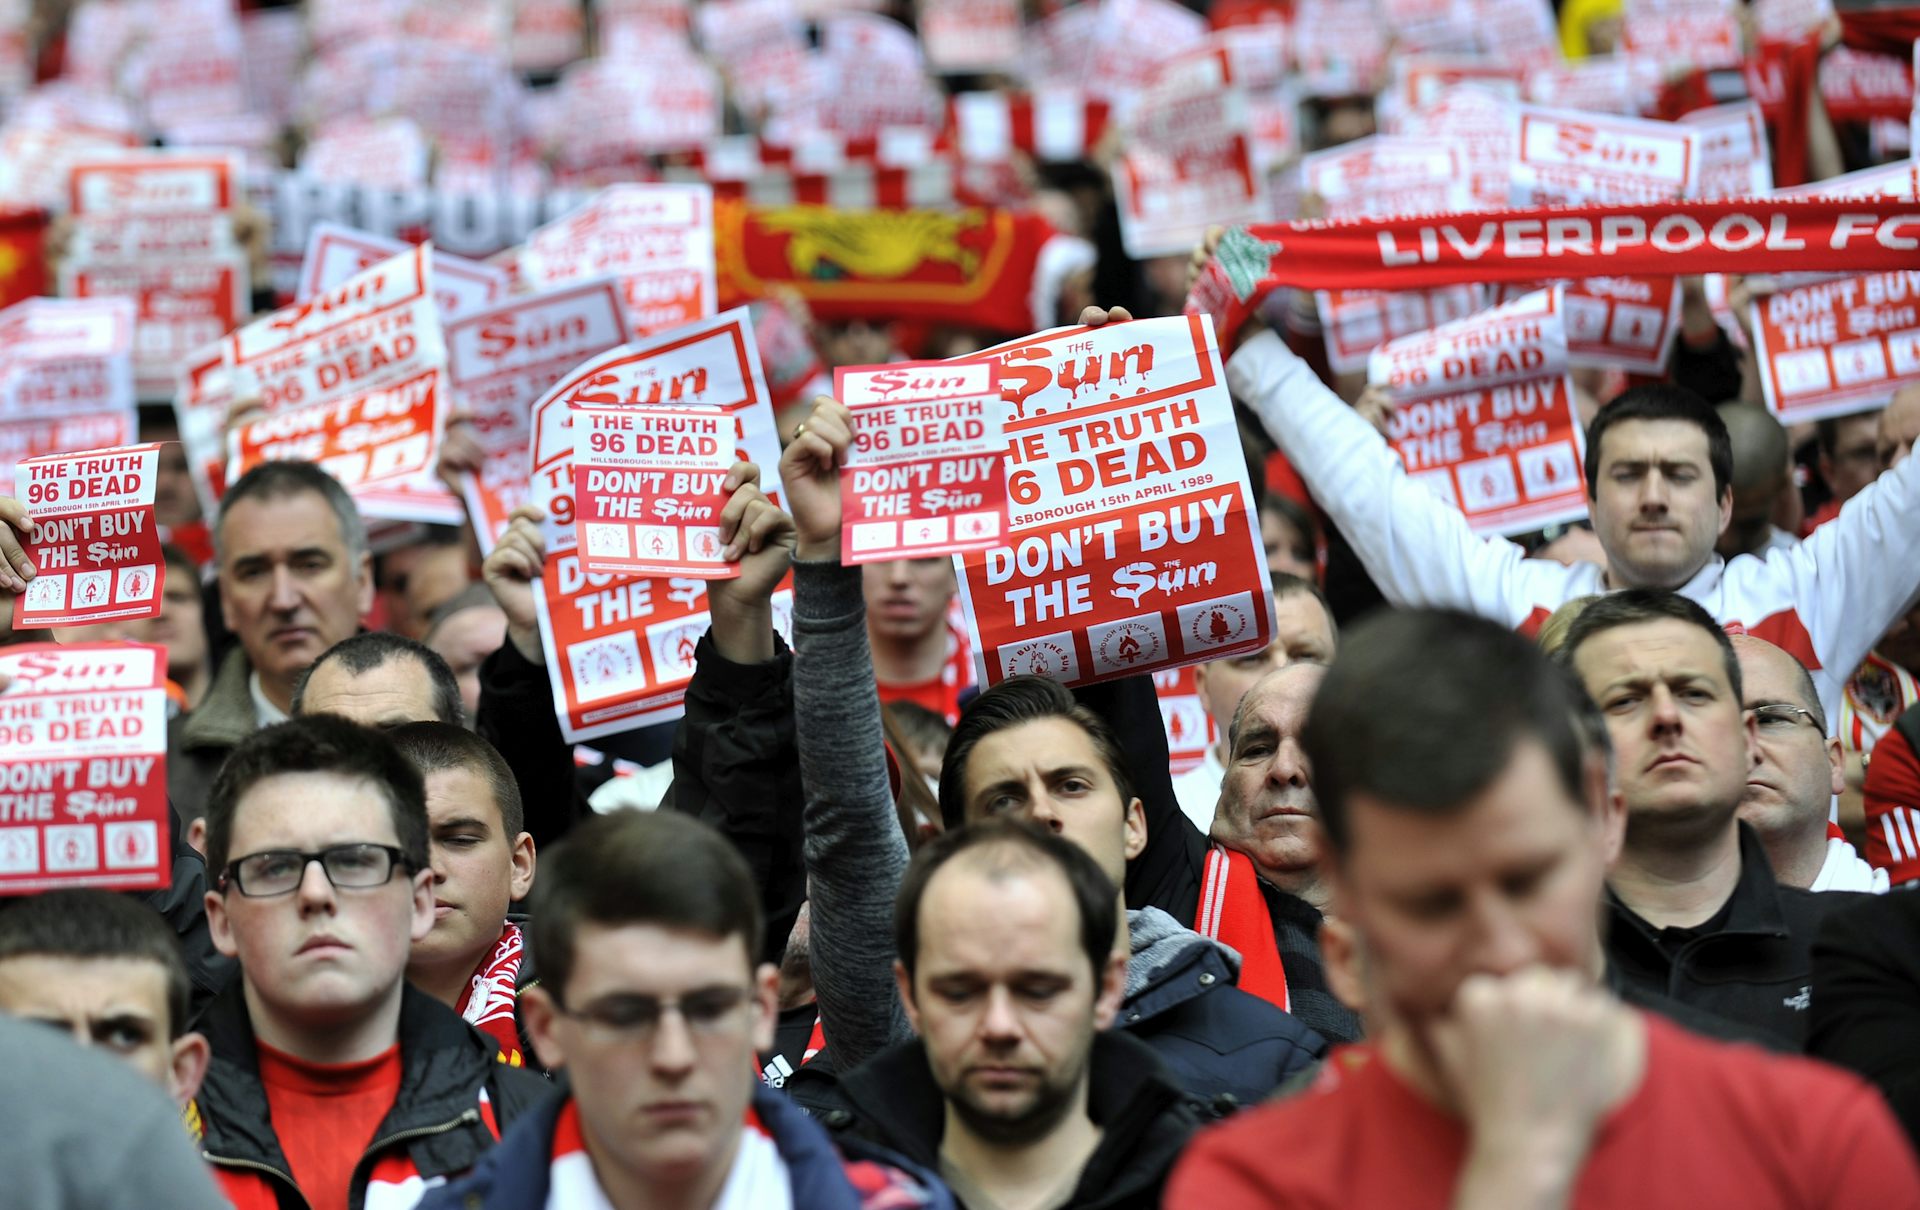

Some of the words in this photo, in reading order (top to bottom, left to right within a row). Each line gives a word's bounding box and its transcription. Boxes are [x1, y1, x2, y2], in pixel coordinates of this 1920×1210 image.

[1376, 212, 1806, 266] LIVERPOOL
[1829, 213, 1920, 250] FC
[1768, 278, 1858, 327] DON'T
[253, 352, 307, 381] THE
[318, 310, 414, 355] TRUTH
[478, 313, 588, 359] Sun
[1066, 340, 1095, 354] THE
[1451, 322, 1542, 349] TRUTH
[1781, 313, 1838, 349] THE
[316, 333, 417, 391] DEAD
[1442, 348, 1545, 380] DEAD
[869, 371, 966, 400] Sun
[1000, 343, 1155, 419] Sun
[1491, 378, 1557, 419] BUY
[588, 414, 634, 431] THE
[641, 416, 718, 434] TRUTH
[852, 409, 897, 430] THE
[904, 400, 983, 423] TRUTH
[590, 432, 626, 453] 96
[635, 434, 718, 457] DEAD
[854, 430, 890, 454] 96
[900, 418, 984, 447] DEAD
[1002, 432, 1050, 468] HE
[1058, 398, 1200, 454] TRUTH
[1402, 428, 1463, 470] THE
[29, 462, 68, 481] THE
[75, 455, 143, 477] TRUTH
[590, 456, 653, 465] HILLSBOROUGH
[674, 459, 698, 467] APRIL
[853, 461, 932, 494] DON'T
[938, 456, 997, 485] BUY
[1008, 469, 1042, 505] 6
[1055, 431, 1208, 497] DEAD
[28, 482, 60, 504] 96
[68, 473, 142, 500] DEAD
[586, 469, 666, 495] DON'T
[671, 472, 728, 496] BUY
[28, 503, 83, 516] HILLSBOROUGH
[84, 501, 99, 510] 15th
[101, 499, 121, 509] APRIL
[549, 494, 577, 527] 9
[594, 495, 643, 519] THE
[860, 493, 912, 518] THE
[1009, 500, 1096, 529] LSBOROUGH
[1100, 493, 1131, 508] 15th
[1135, 482, 1177, 500] APRIL
[1180, 473, 1214, 490] 1989
[31, 516, 93, 546] DON'T
[100, 510, 146, 538] BUY
[984, 518, 1126, 587] DON'T
[1138, 493, 1234, 553] BUY
[37, 544, 80, 570] THE
[573, 579, 655, 631] THE
[1004, 572, 1094, 628] THE
[1110, 559, 1218, 609] Sun
[1209, 603, 1239, 612] JUSTICE
[1118, 623, 1150, 633] JUSTICE
[16, 651, 126, 691] Sun
[1016, 642, 1039, 657] BUY
[1043, 641, 1064, 655] THE
[1060, 654, 1070, 672] SUN
[0, 702, 45, 722] THE
[56, 695, 145, 718] TRUTH
[0, 724, 34, 746] 96
[48, 716, 144, 743] DEAD
[87, 757, 154, 789] BUY
[0, 791, 55, 821] THE
